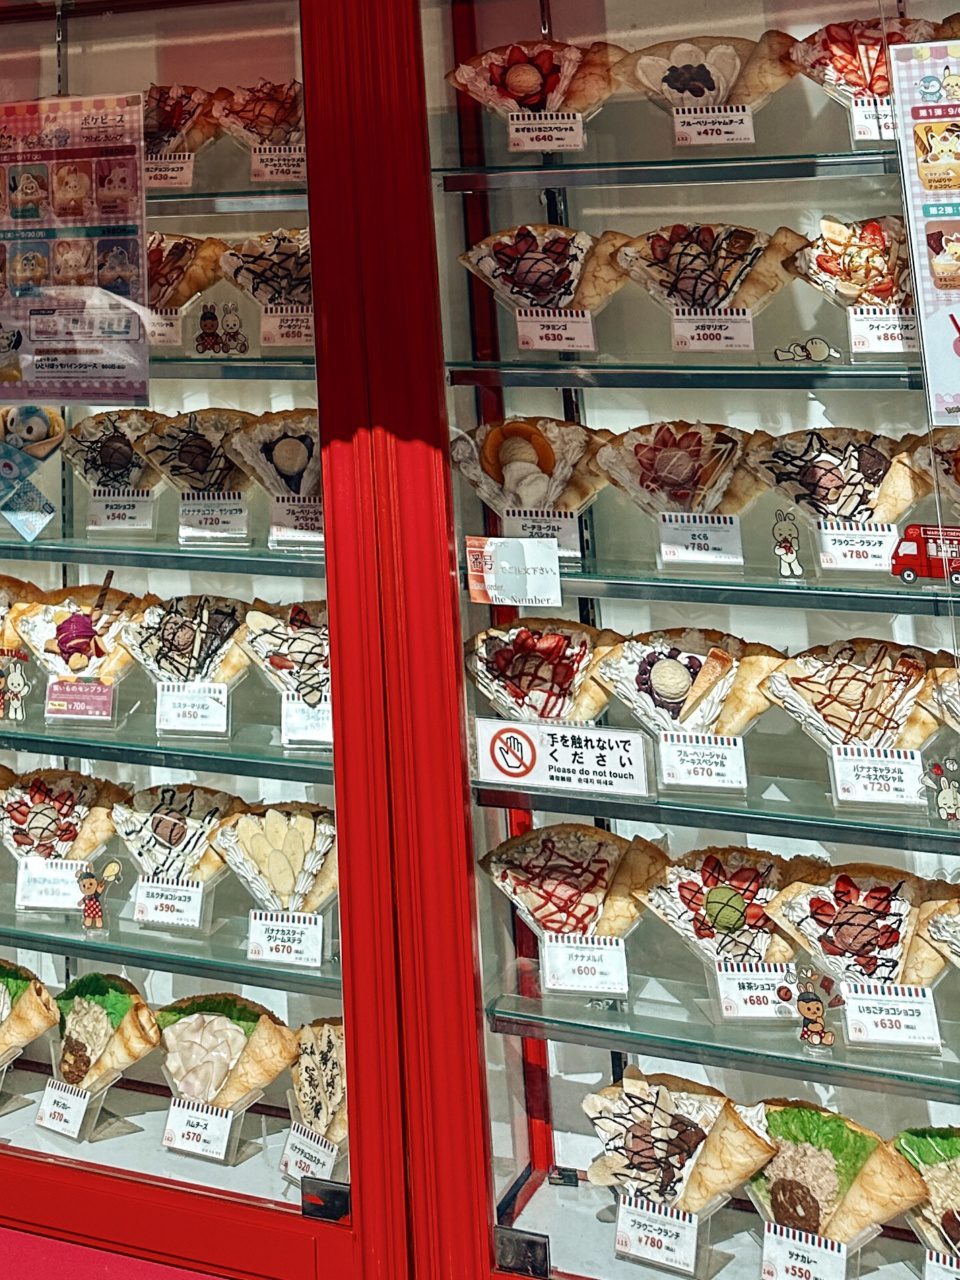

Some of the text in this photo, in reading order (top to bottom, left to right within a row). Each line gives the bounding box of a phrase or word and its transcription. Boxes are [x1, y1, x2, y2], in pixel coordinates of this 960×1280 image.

[81, 114, 126, 126] ポケピース
[680, 119, 745, 127] ブルーベリージャムチーズ
[696, 128, 722, 136] ¥470
[530, 134, 554, 142] ¥640
[539, 333, 564, 341] ¥630
[690, 333, 722, 341] ¥1000
[877, 333, 903, 341] ¥860
[107, 513, 127, 521] ¥540
[198, 517, 220, 525] ¥720
[293, 522, 317, 530] ¥550
[691, 533, 709, 541] さくら
[684, 543, 710, 551] ¥780
[830, 539, 884, 548] ブラウニークランチ
[843, 550, 869, 559] ¥780
[472, 554, 493, 571] 番号
[68, 702, 86, 710] ¥700
[177, 710, 198, 719] ¥850
[547, 733, 632, 753] 手を触れないで
[676, 750, 728, 761] ブルーベリージャム
[679, 758, 726, 768] ケーキスペシャル
[548, 764, 635, 780] Please do not touch
[686, 767, 713, 777] ¥670
[853, 765, 904, 775] バナナキャラメル
[854, 773, 904, 783] ケーキスペシャル
[863, 782, 891, 792] ¥720
[146, 891, 192, 903] ミルクチョコショコラ
[154, 904, 175, 913] ¥590
[264, 927, 306, 938] バナナカスタード
[266, 935, 303, 945] クリームステラ
[269, 944, 293, 955] ¥670
[572, 965, 597, 976] ¥600
[743, 996, 769, 1006] ¥680
[858, 1005, 921, 1017] いちごチョコショコラ
[874, 1019, 901, 1030] ¥630
[49, 1111, 64, 1122] ¥570
[186, 1119, 209, 1131] ハムチーズ
[181, 1131, 202, 1143] ¥570
[294, 1158, 311, 1173] ¥520
[630, 1218, 680, 1240] ブラウニークランチ
[638, 1235, 663, 1250] ¥780
[788, 1250, 818, 1266] ツナカレー
[785, 1266, 811, 1280] ¥550
